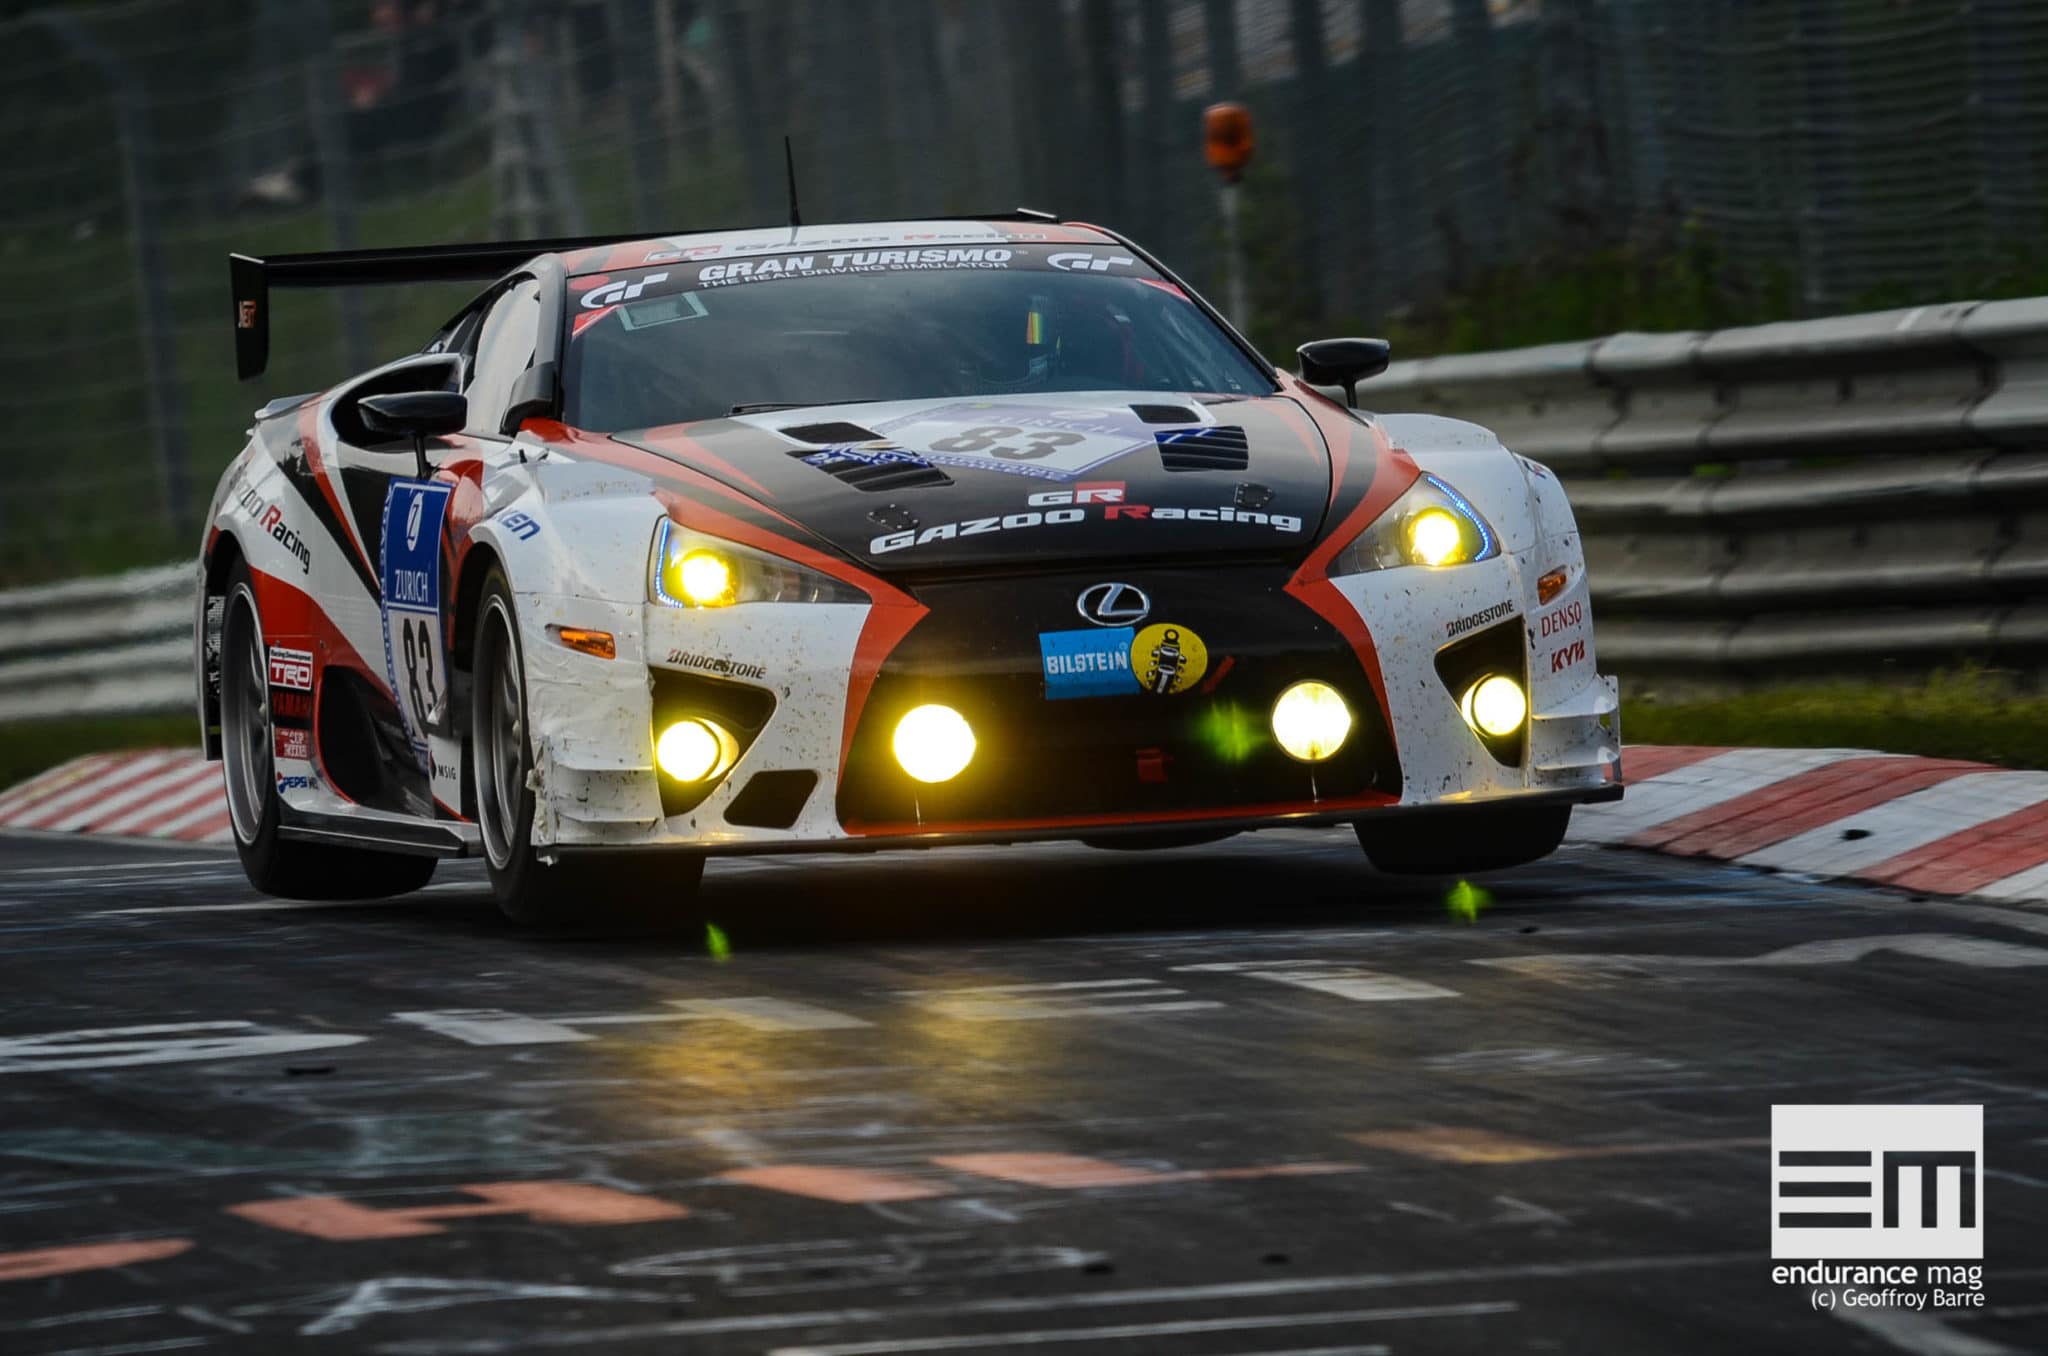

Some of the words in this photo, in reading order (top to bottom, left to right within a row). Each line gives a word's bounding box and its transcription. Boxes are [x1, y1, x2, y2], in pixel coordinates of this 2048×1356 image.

[698, 256, 814, 282] GRAN
[828, 249, 1012, 267] TURISMO
[698, 277, 740, 288] THE
[745, 271, 796, 283] REAL
[802, 264, 886, 277] DRIVING
[891, 261, 1008, 270] SIMULATOR
[928, 426, 1086, 461] 83
[1028, 487, 1122, 507] GR
[259, 504, 311, 575] Racing
[870, 508, 1085, 555] GAZOO
[1104, 503, 1301, 533] Racing
[395, 569, 429, 603] ZURICH
[1446, 599, 1514, 638] BRIDGESTONE
[1541, 601, 1582, 638] DENSO
[271, 662, 310, 685] TRD
[666, 648, 768, 680] BRIDGESTONE
[1046, 651, 1129, 674] BILSTEIN
[438, 764, 457, 780] MSIG
